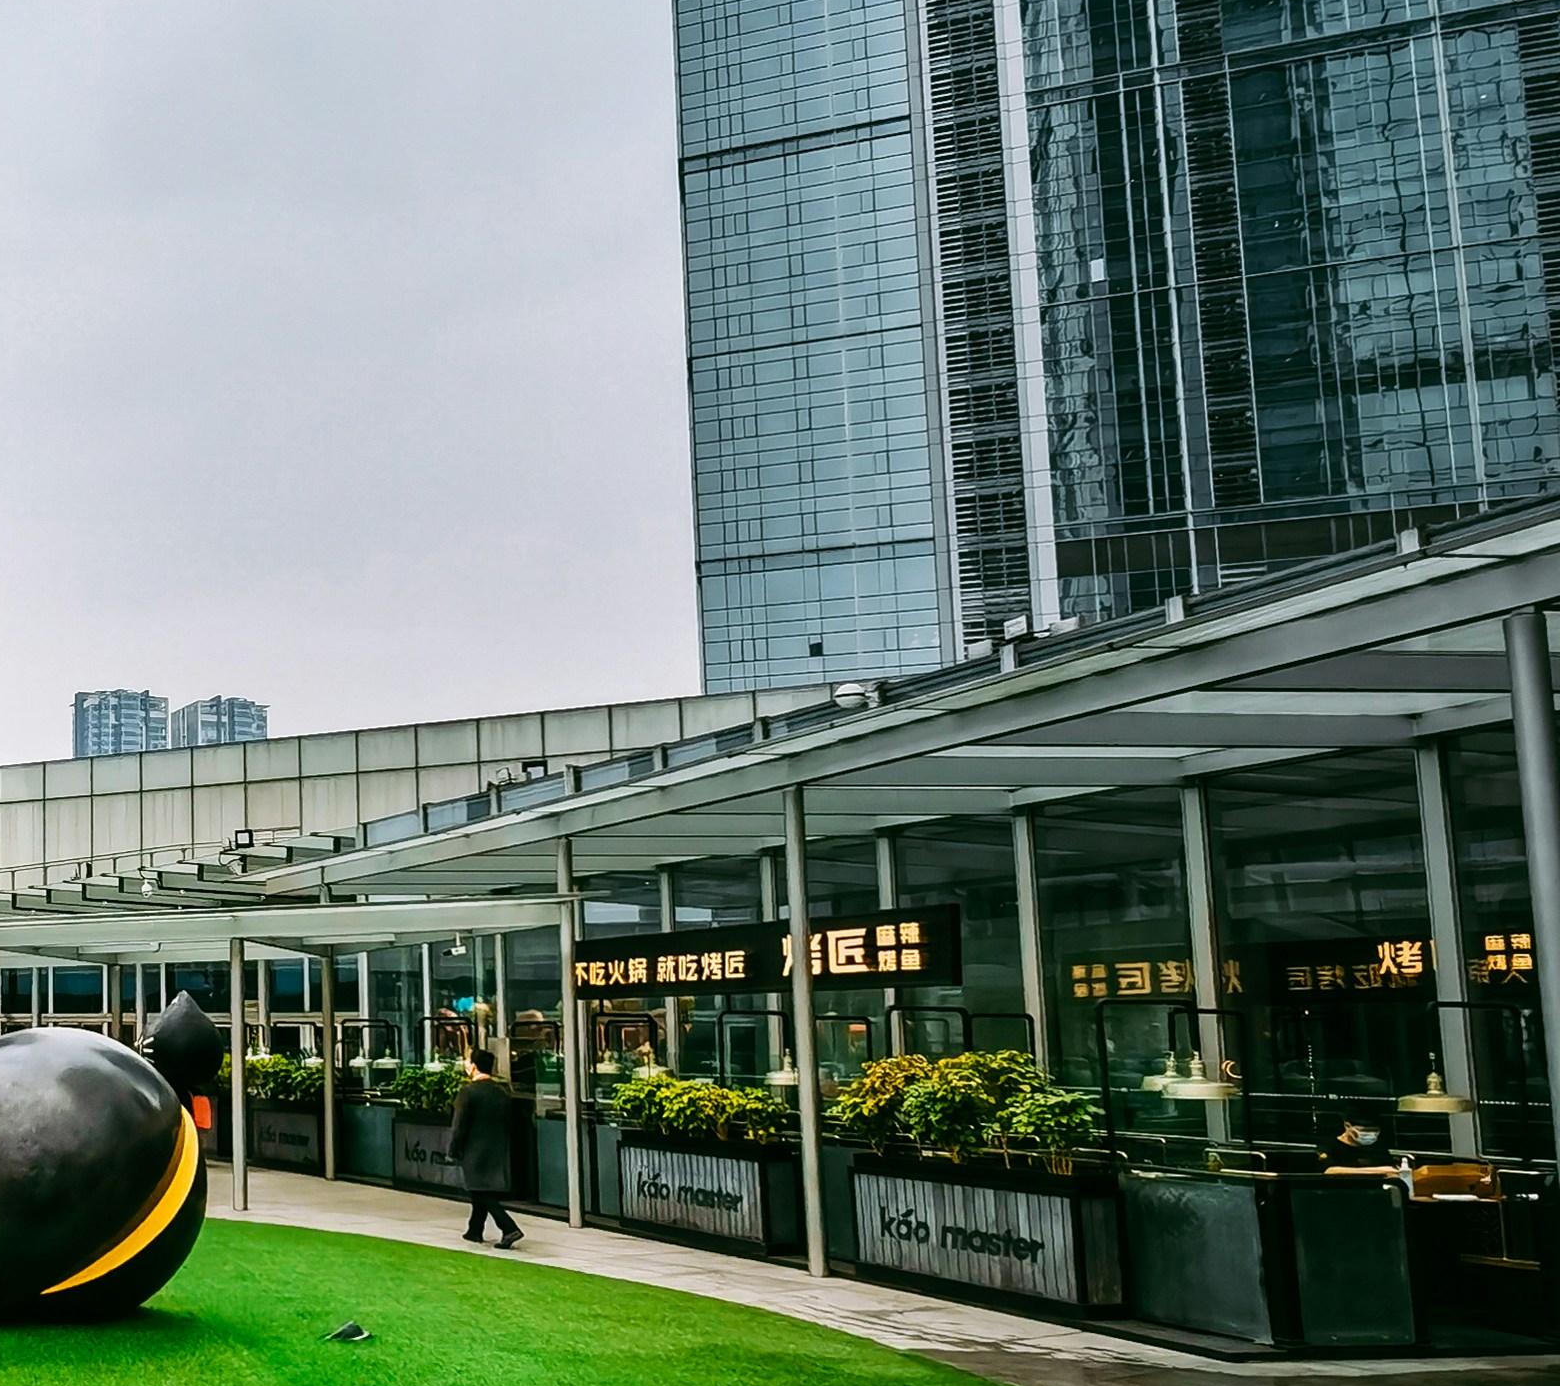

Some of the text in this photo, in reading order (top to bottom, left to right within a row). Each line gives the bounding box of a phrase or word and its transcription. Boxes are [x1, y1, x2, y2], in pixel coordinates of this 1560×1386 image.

[656, 949, 746, 983] 就吃烤匠
[940, 1225, 1045, 1264] master
